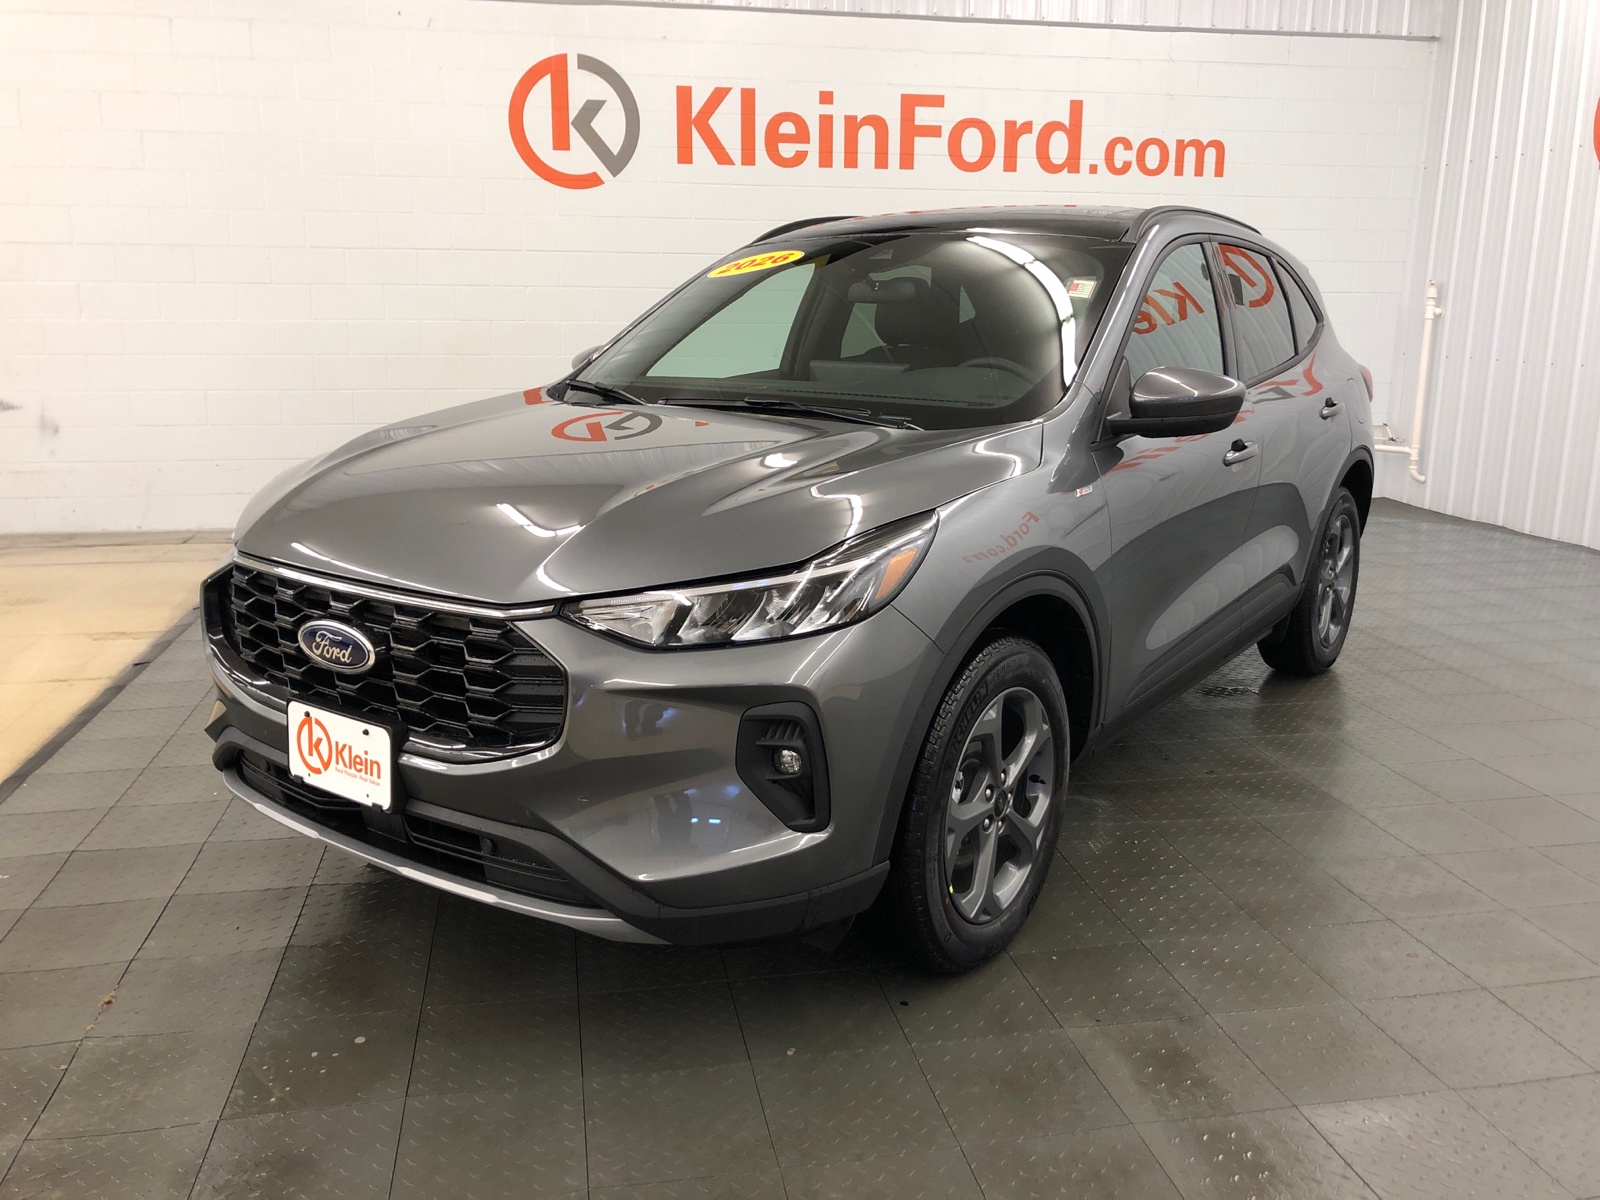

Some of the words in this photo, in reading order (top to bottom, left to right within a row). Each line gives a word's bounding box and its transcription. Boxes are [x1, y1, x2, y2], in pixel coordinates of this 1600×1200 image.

[675, 84, 1227, 179] KleinFord.com
[715, 252, 795, 276] 2026
[312, 630, 353, 663] Ford
[335, 740, 381, 780] Klein
